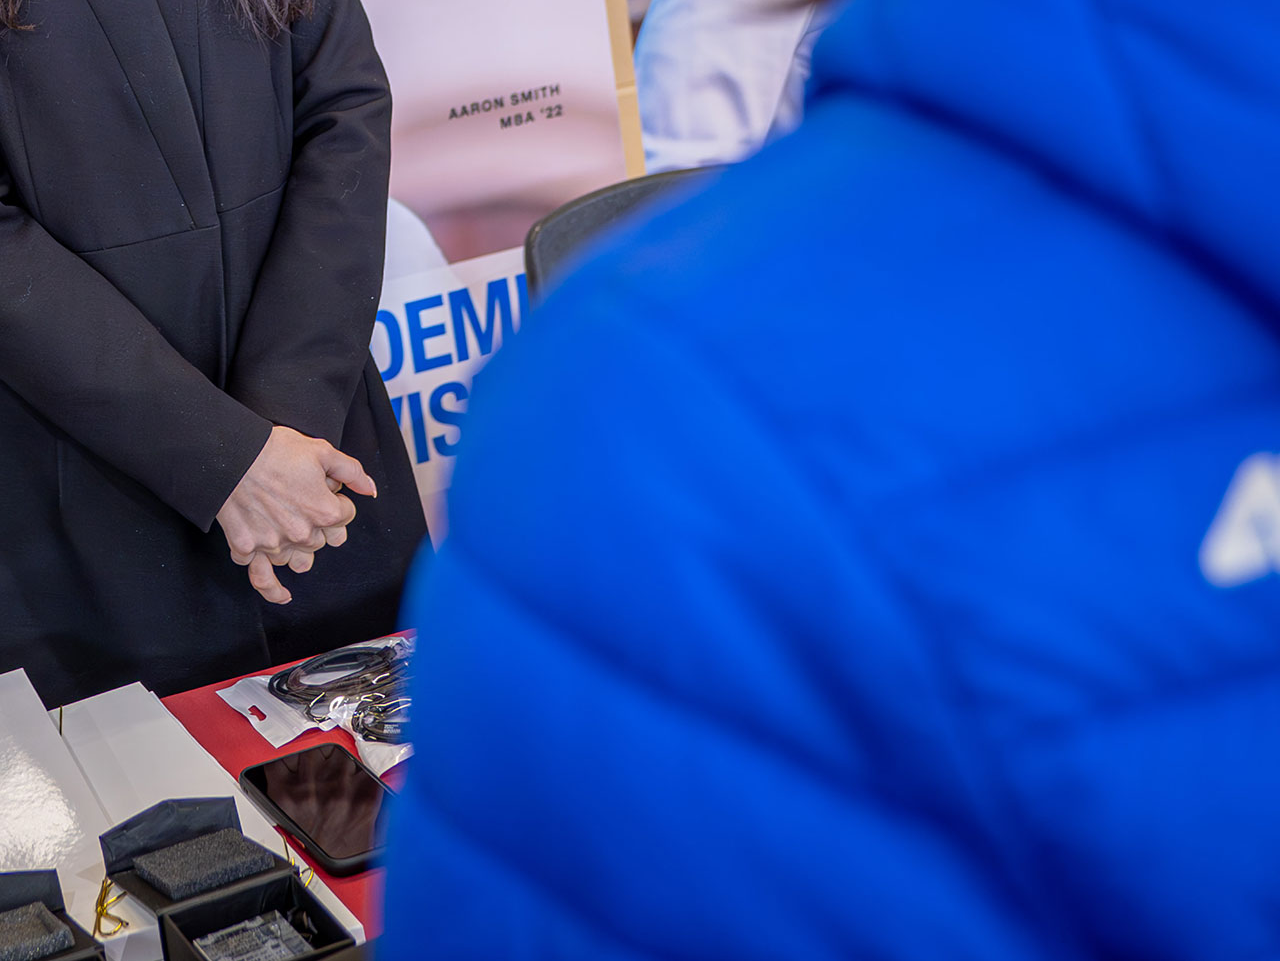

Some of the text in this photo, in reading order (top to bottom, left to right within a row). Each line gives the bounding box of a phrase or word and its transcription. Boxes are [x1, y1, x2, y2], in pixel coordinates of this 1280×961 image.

[448, 83, 560, 120] AARON SMITH
[499, 110, 534, 129] MBA
